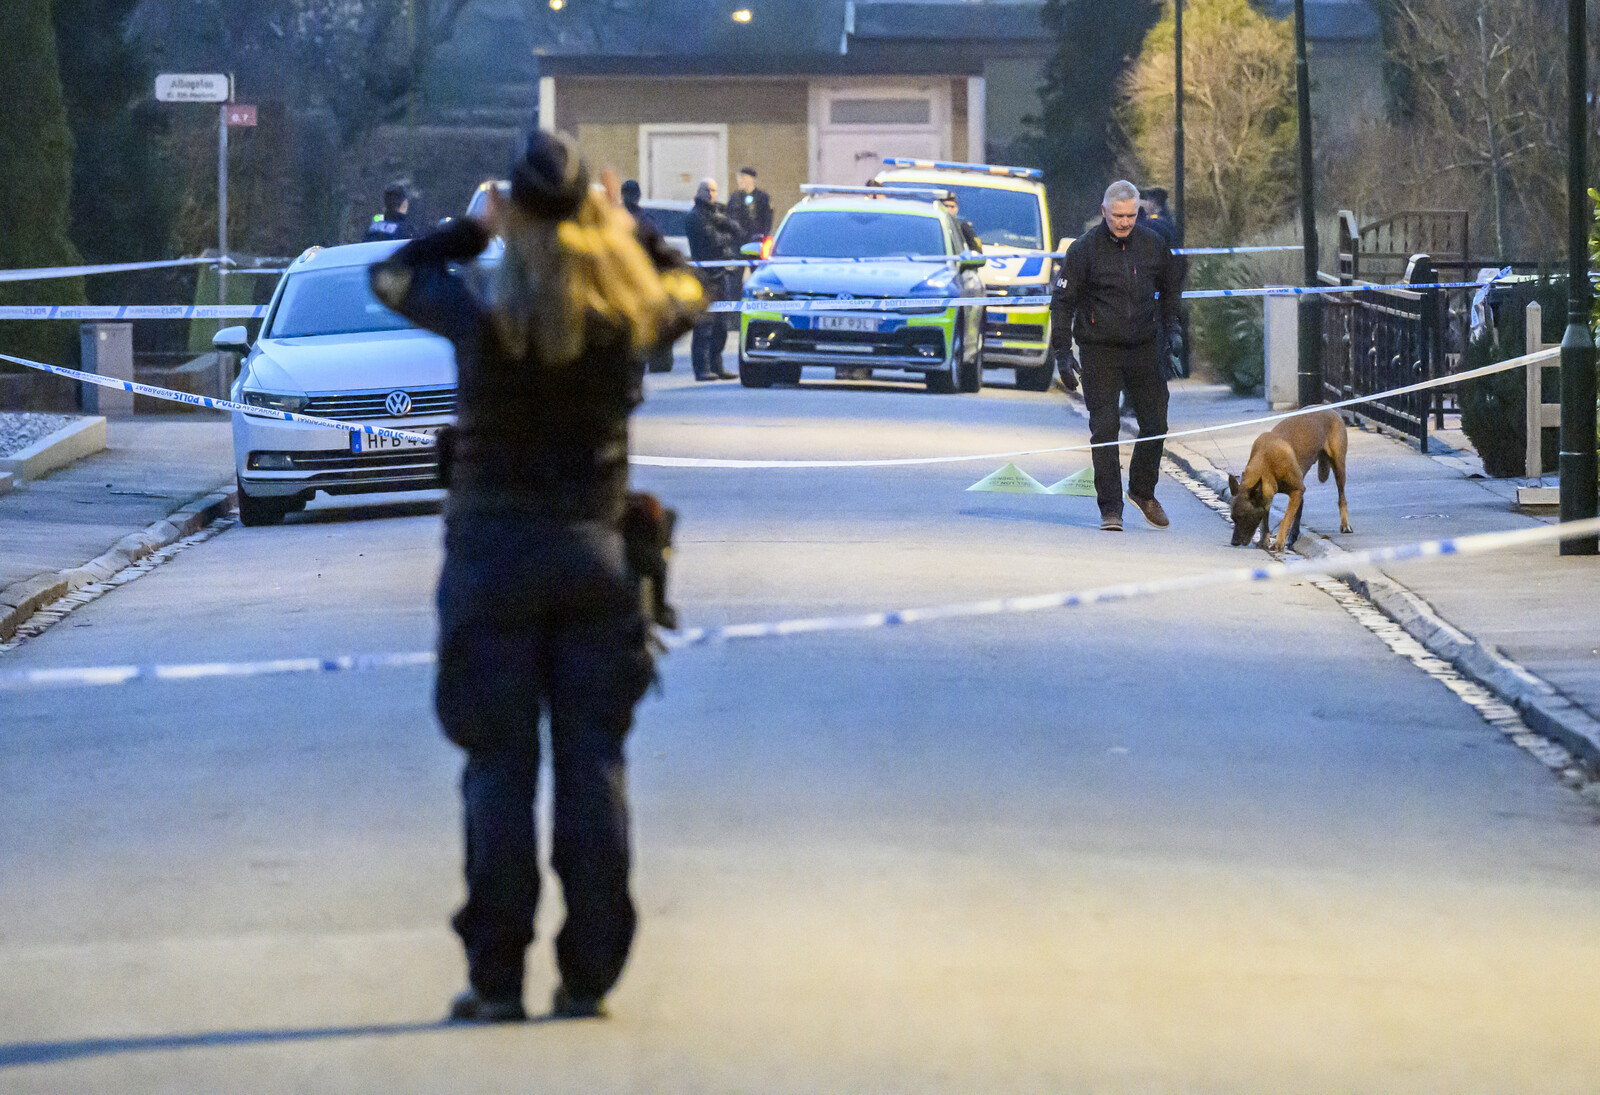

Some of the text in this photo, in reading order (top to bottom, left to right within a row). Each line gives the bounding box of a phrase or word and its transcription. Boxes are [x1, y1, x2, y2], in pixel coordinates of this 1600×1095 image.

[173, 392, 200, 404] POLIS
[216, 399, 242, 410] POLIS
[378, 428, 404, 440] POLIS
